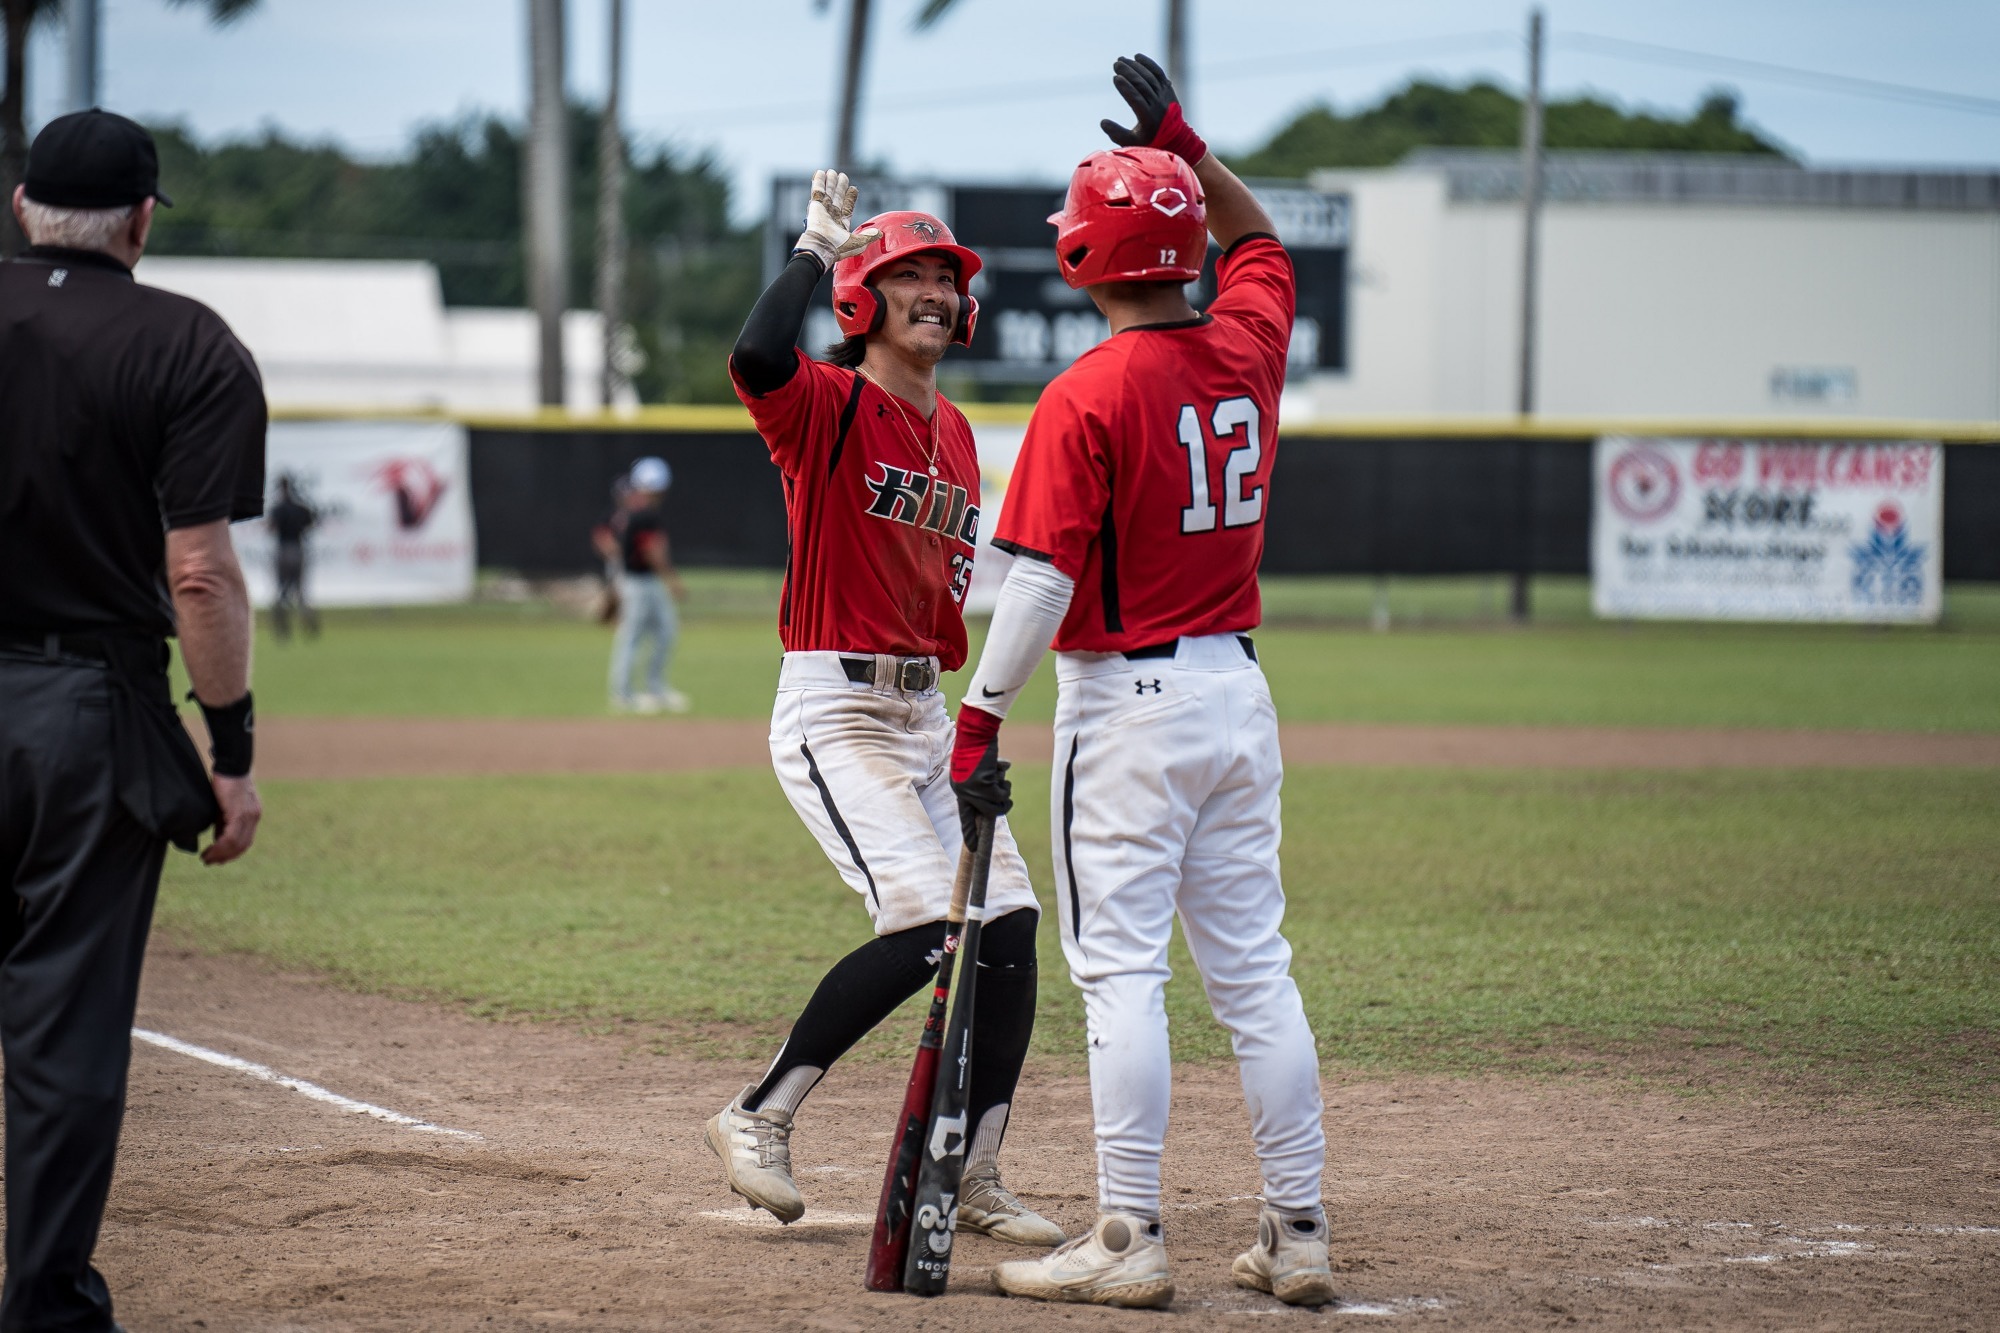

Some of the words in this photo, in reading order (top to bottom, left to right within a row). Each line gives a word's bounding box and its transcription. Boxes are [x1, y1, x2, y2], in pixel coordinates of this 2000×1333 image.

[1160, 249, 1177, 265] 12
[864, 461, 981, 548] Hilo
[1176, 396, 1263, 534] 12
